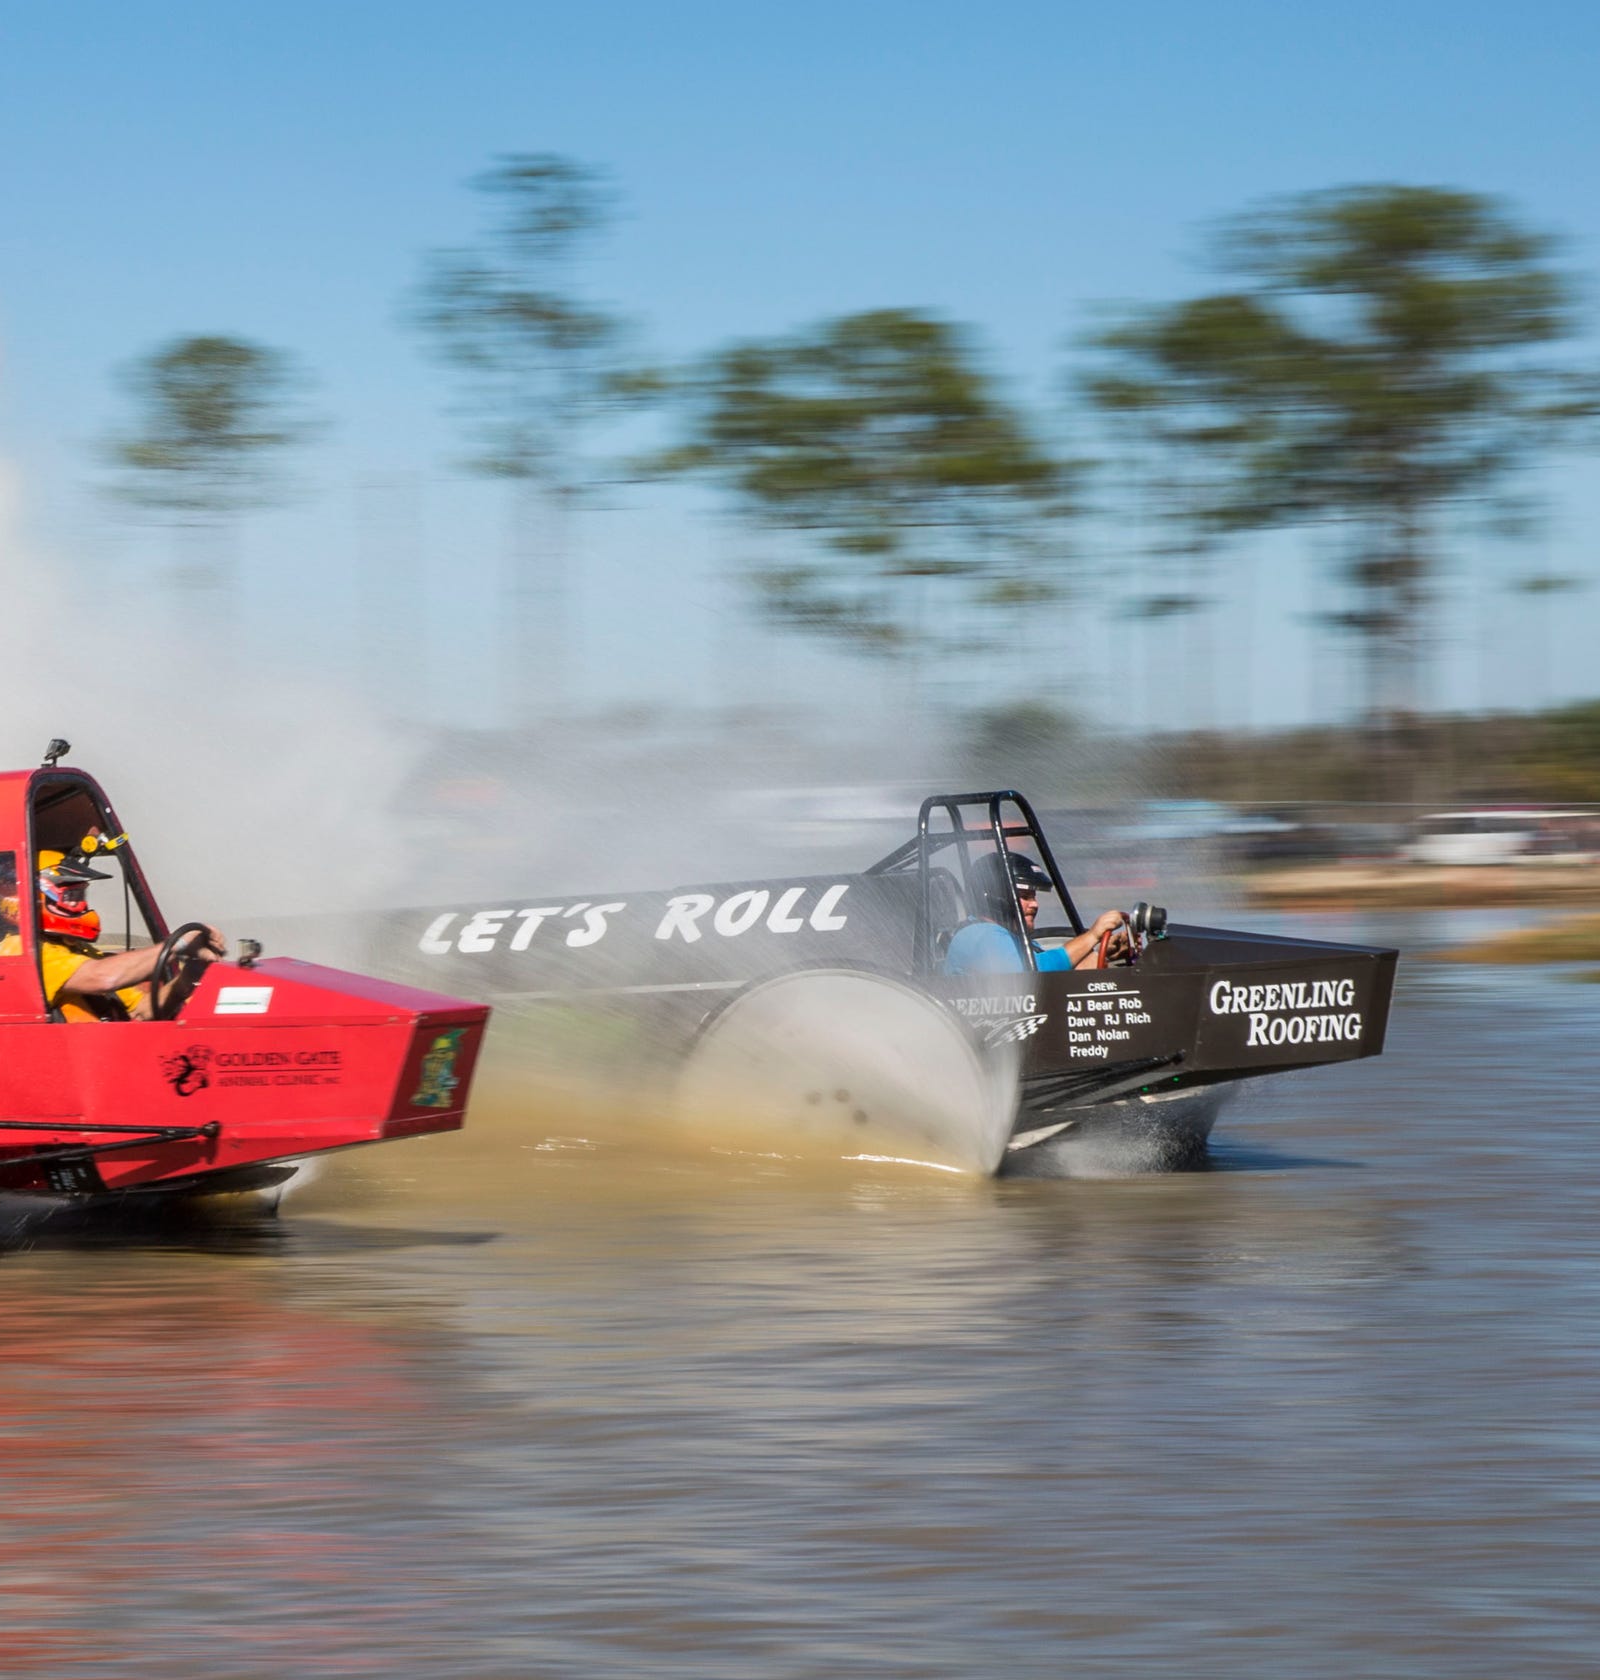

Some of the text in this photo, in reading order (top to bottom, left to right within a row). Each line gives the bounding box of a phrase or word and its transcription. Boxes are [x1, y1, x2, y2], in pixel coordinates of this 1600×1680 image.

[417, 884, 850, 955] LET'S ROLL
[1087, 982, 1118, 993] CREW:
[1210, 978, 1356, 1015] GREENLING
[949, 994, 1037, 1016] EENLING
[1066, 997, 1142, 1013] AJ Bear Rob
[1068, 1012, 1151, 1028] Dave RJ Rich
[1068, 1028, 1130, 1043] Dan Nolan
[1246, 1012, 1363, 1047] ROOFING
[215, 1051, 342, 1067] GOLDEN GATE
[1069, 1045, 1109, 1058] Freddy
